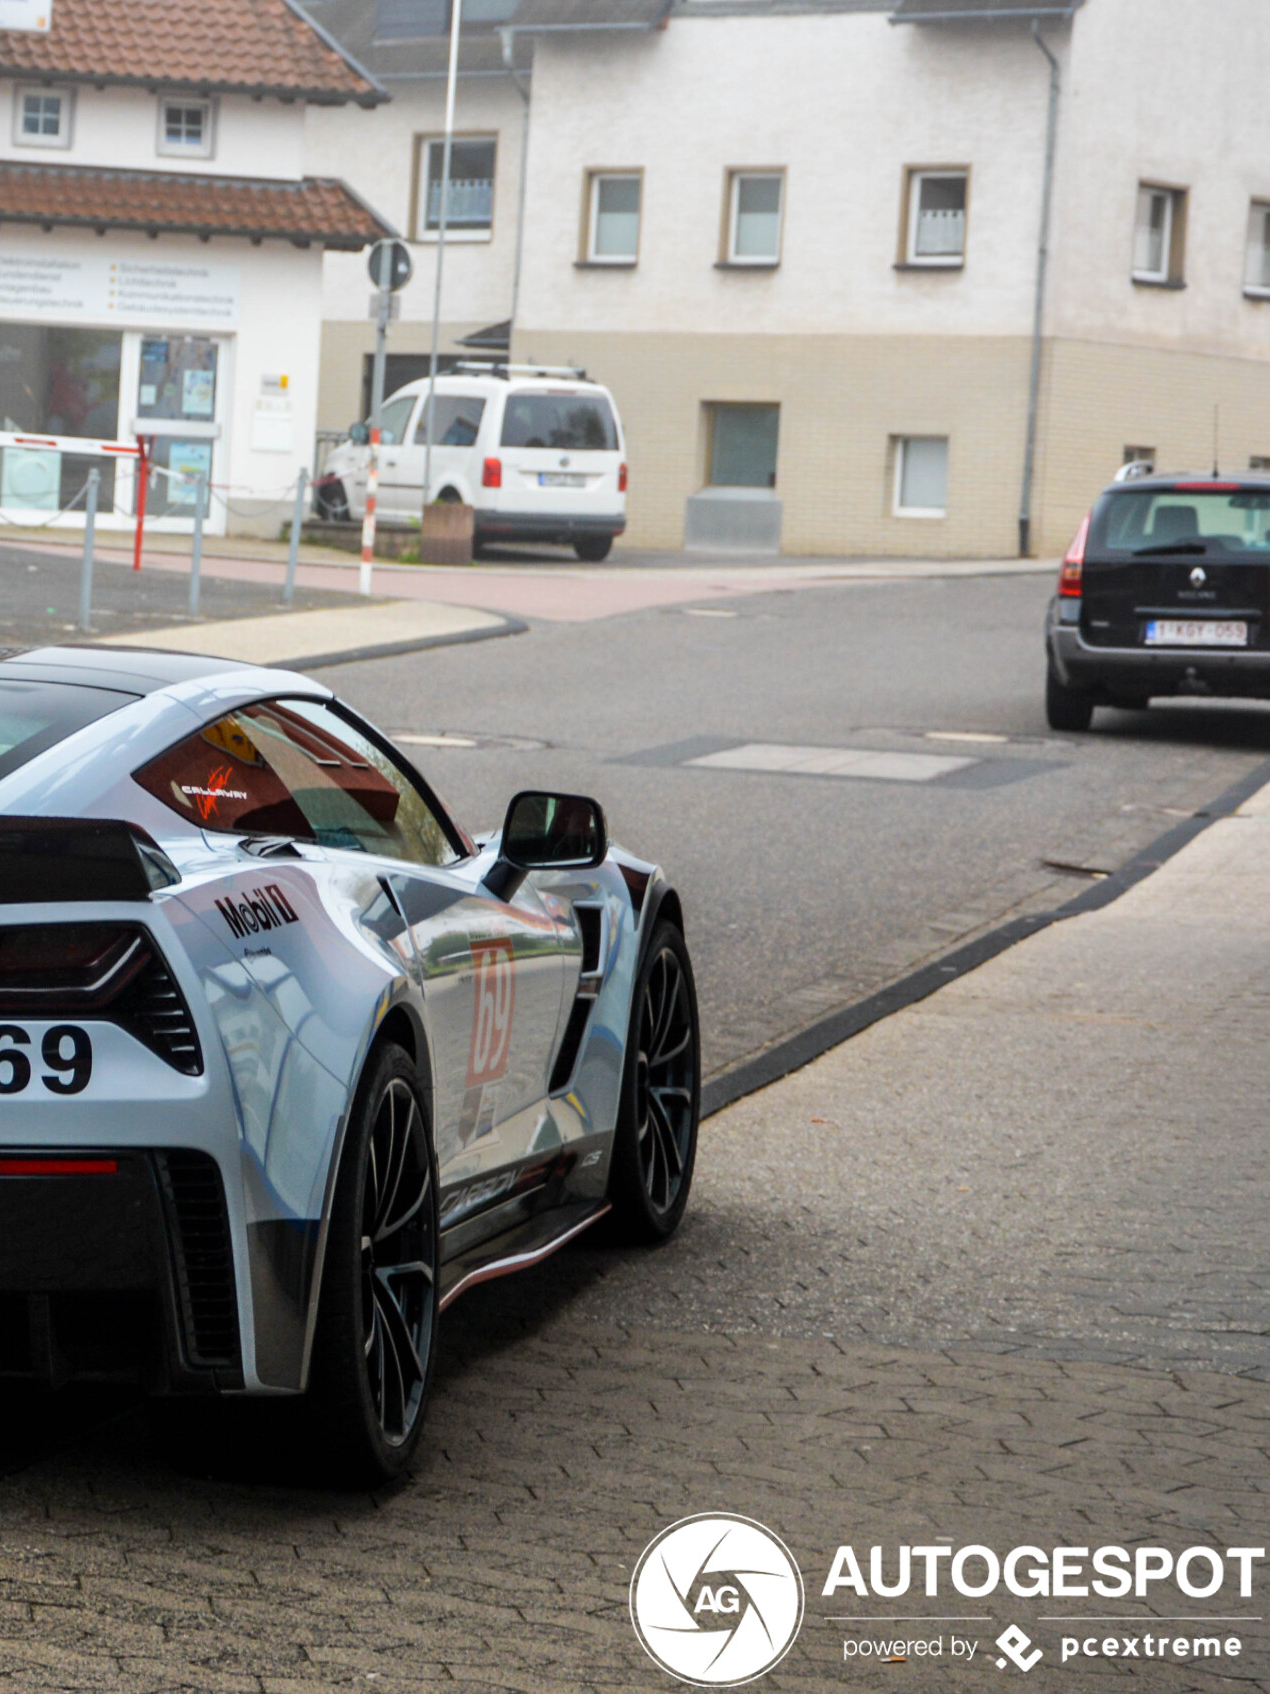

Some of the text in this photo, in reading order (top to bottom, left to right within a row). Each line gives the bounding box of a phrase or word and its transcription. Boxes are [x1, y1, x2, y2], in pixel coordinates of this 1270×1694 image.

[181, 785, 248, 800] CALLAWAY
[214, 887, 282, 940] Mobil
[472, 947, 512, 1075] 69
